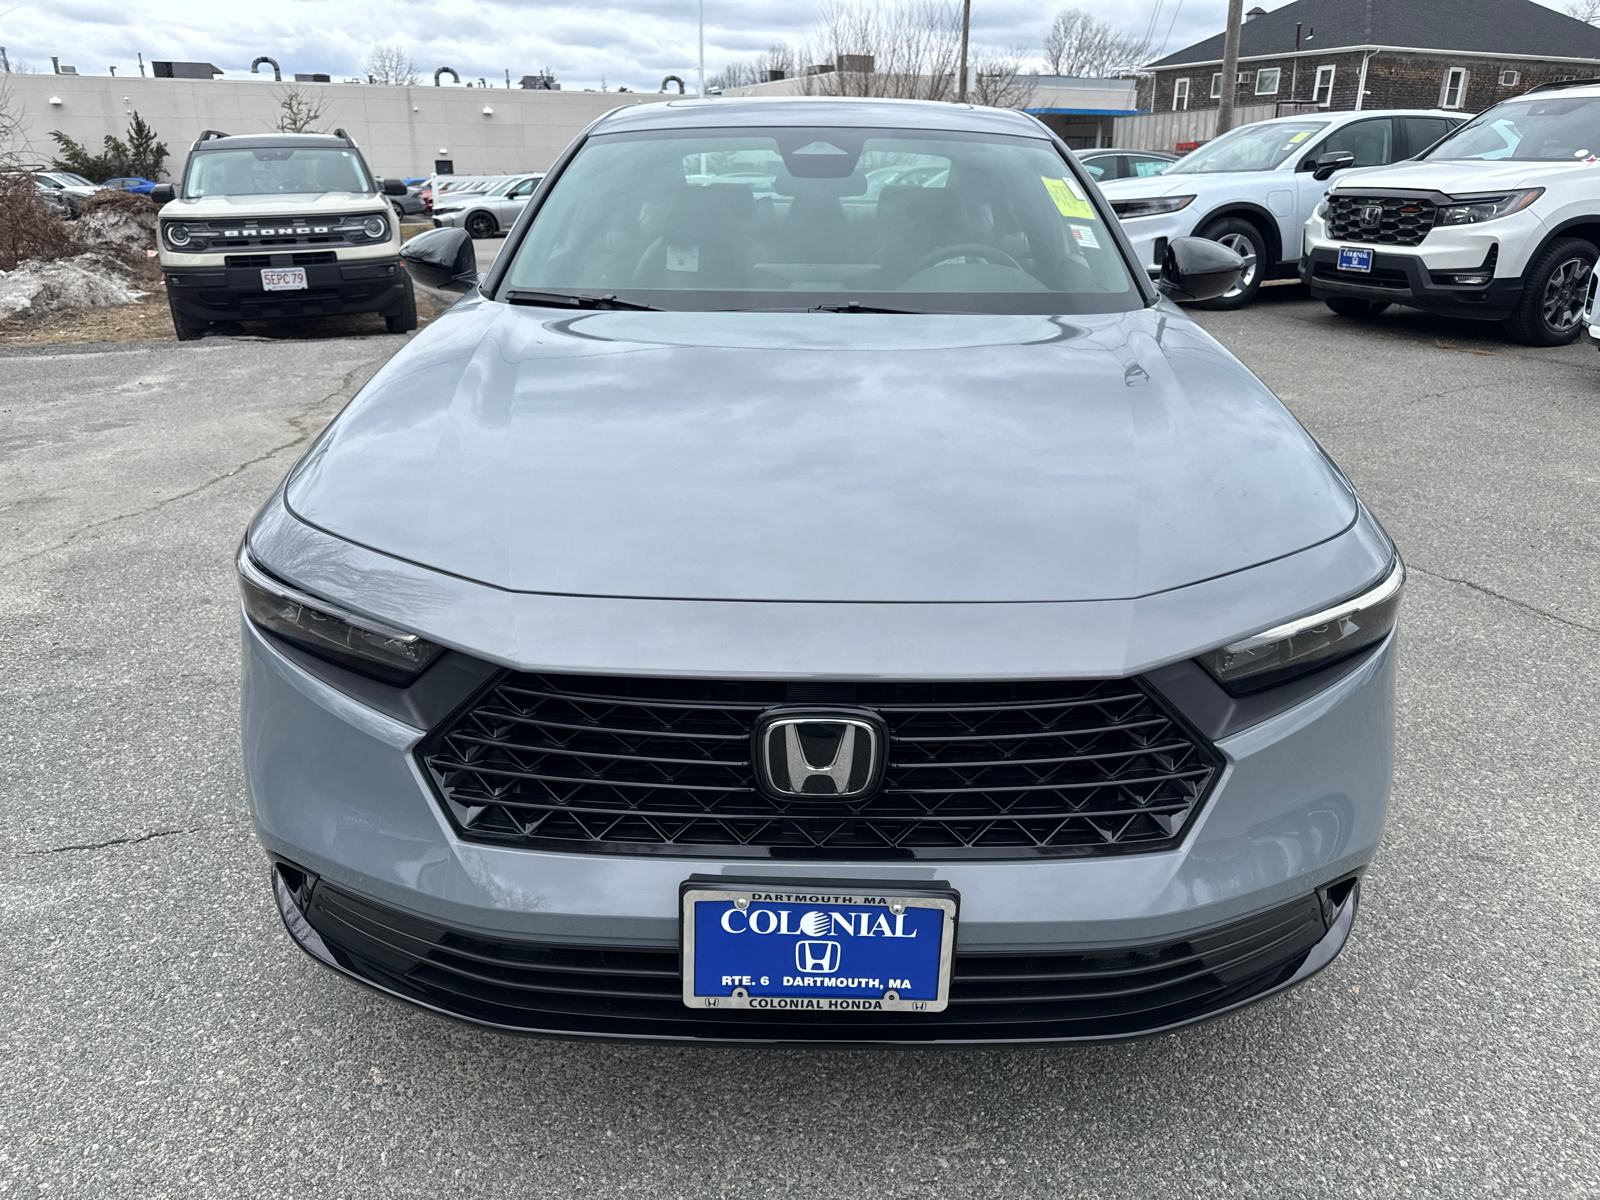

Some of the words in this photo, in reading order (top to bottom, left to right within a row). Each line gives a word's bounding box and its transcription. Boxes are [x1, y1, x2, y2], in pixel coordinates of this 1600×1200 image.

[224, 226, 328, 237] BRONCO
[264, 273, 290, 285] 5EPC
[291, 273, 304, 284] 79
[863, 896, 888, 904] MA
[720, 908, 918, 938] COLONIAL
[721, 975, 756, 987] RTE.
[760, 976, 770, 986] 6
[782, 976, 884, 990] DARTMOUTH,
[888, 979, 912, 990] MA
[748, 998, 823, 1010] COLONIAL
[828, 1000, 883, 1011] HONDA
